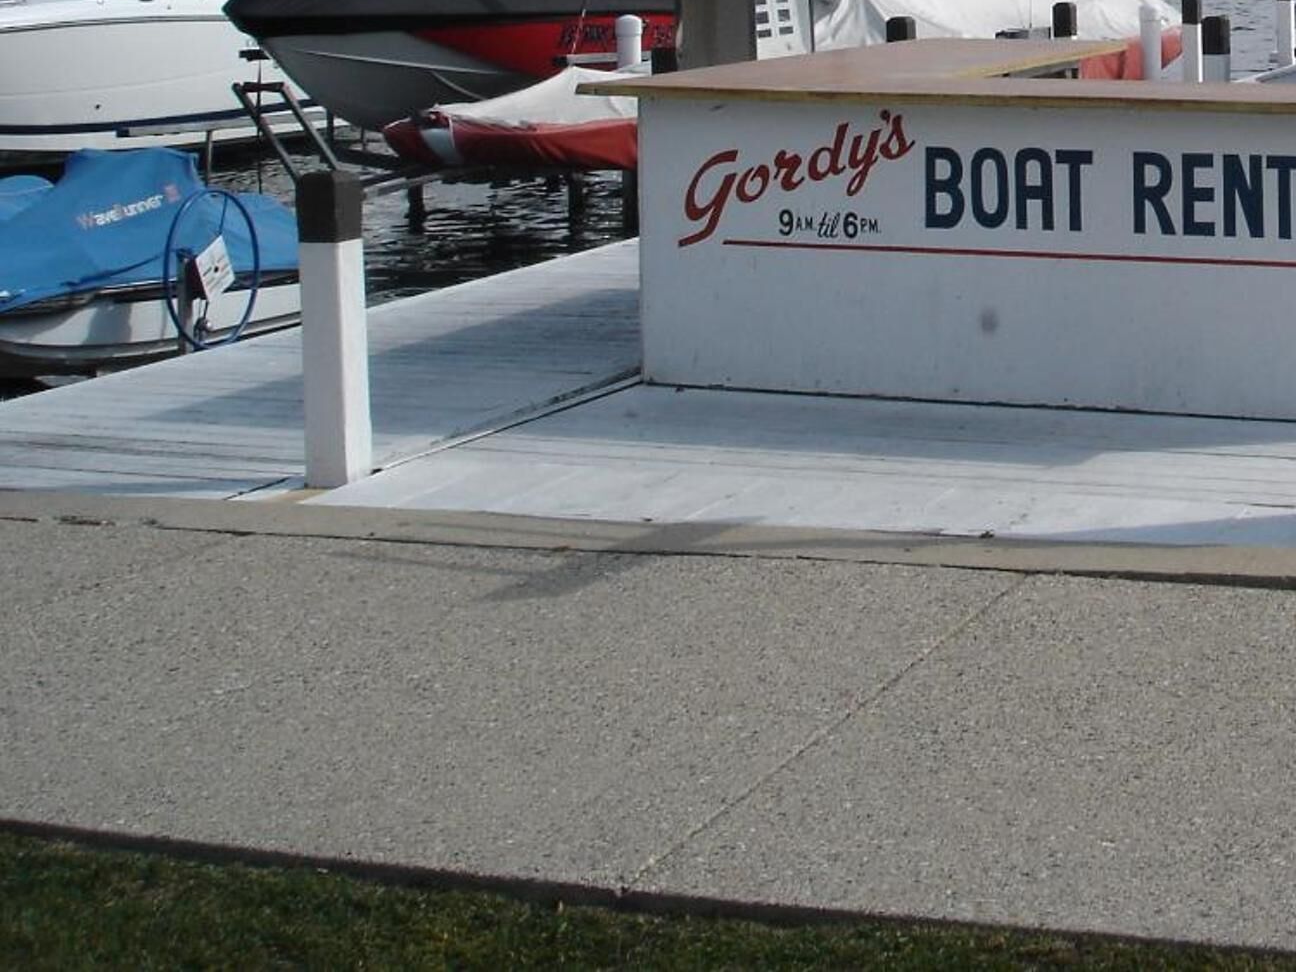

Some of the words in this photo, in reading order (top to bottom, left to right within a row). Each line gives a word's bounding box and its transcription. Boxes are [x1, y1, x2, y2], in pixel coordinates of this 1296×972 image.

[678, 109, 915, 247] Gordy's
[925, 146, 1093, 231] BOAT
[817, 211, 840, 238] til
